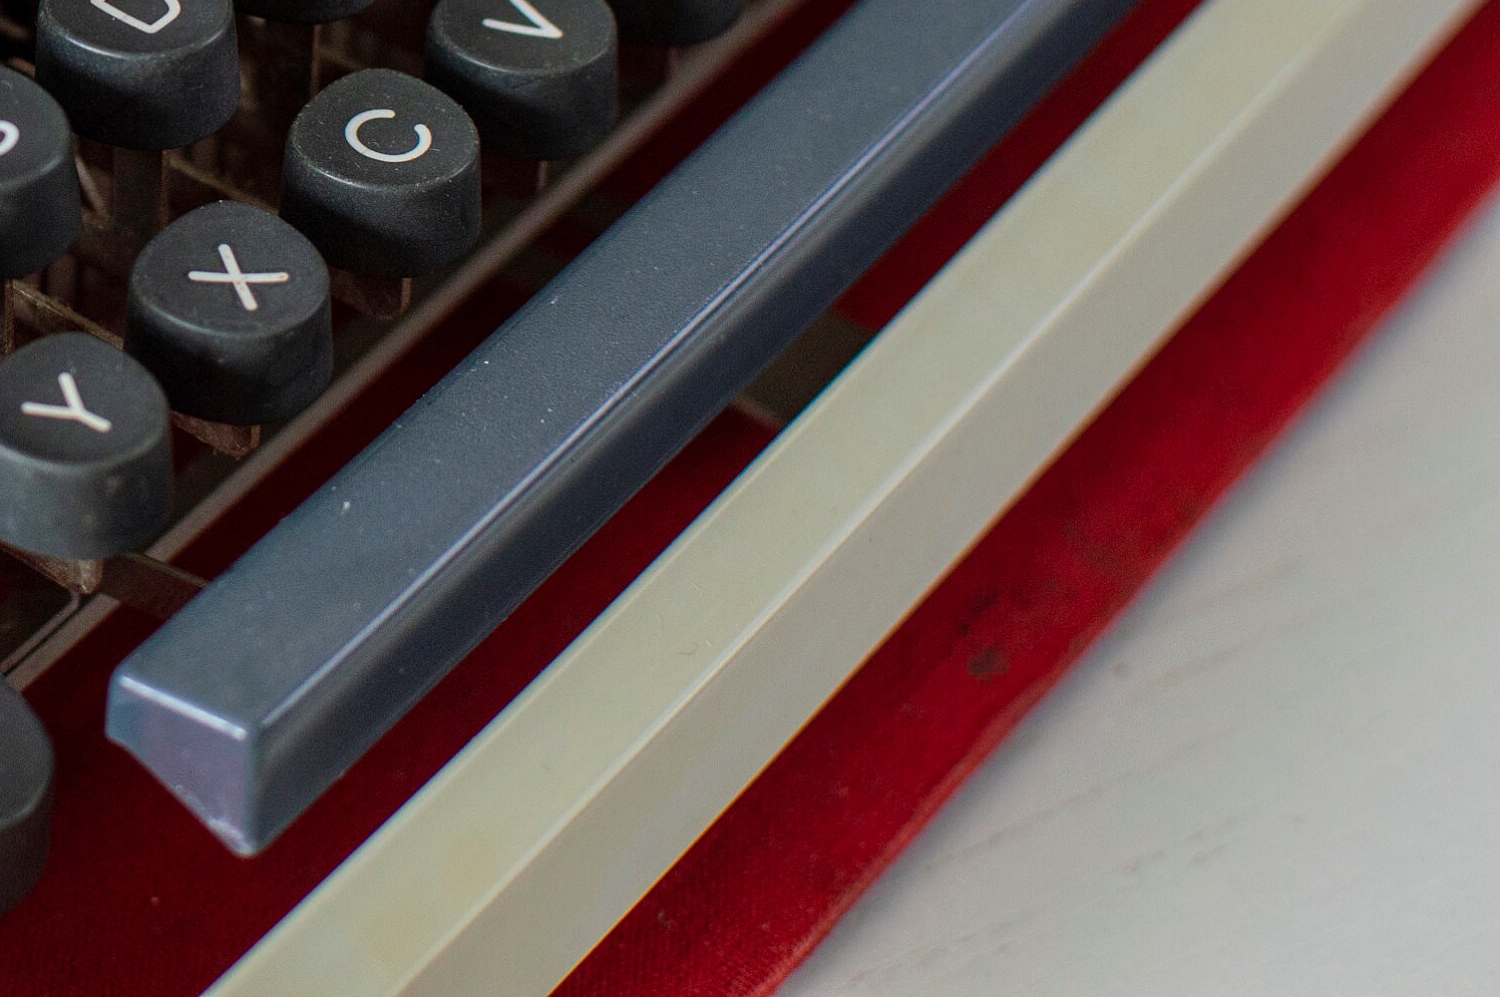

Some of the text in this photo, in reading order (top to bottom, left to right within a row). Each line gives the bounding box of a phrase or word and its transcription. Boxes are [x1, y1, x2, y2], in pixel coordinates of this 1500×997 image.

[344, 107, 434, 164] C
[187, 242, 291, 312] X
[20, 371, 113, 433] Y
